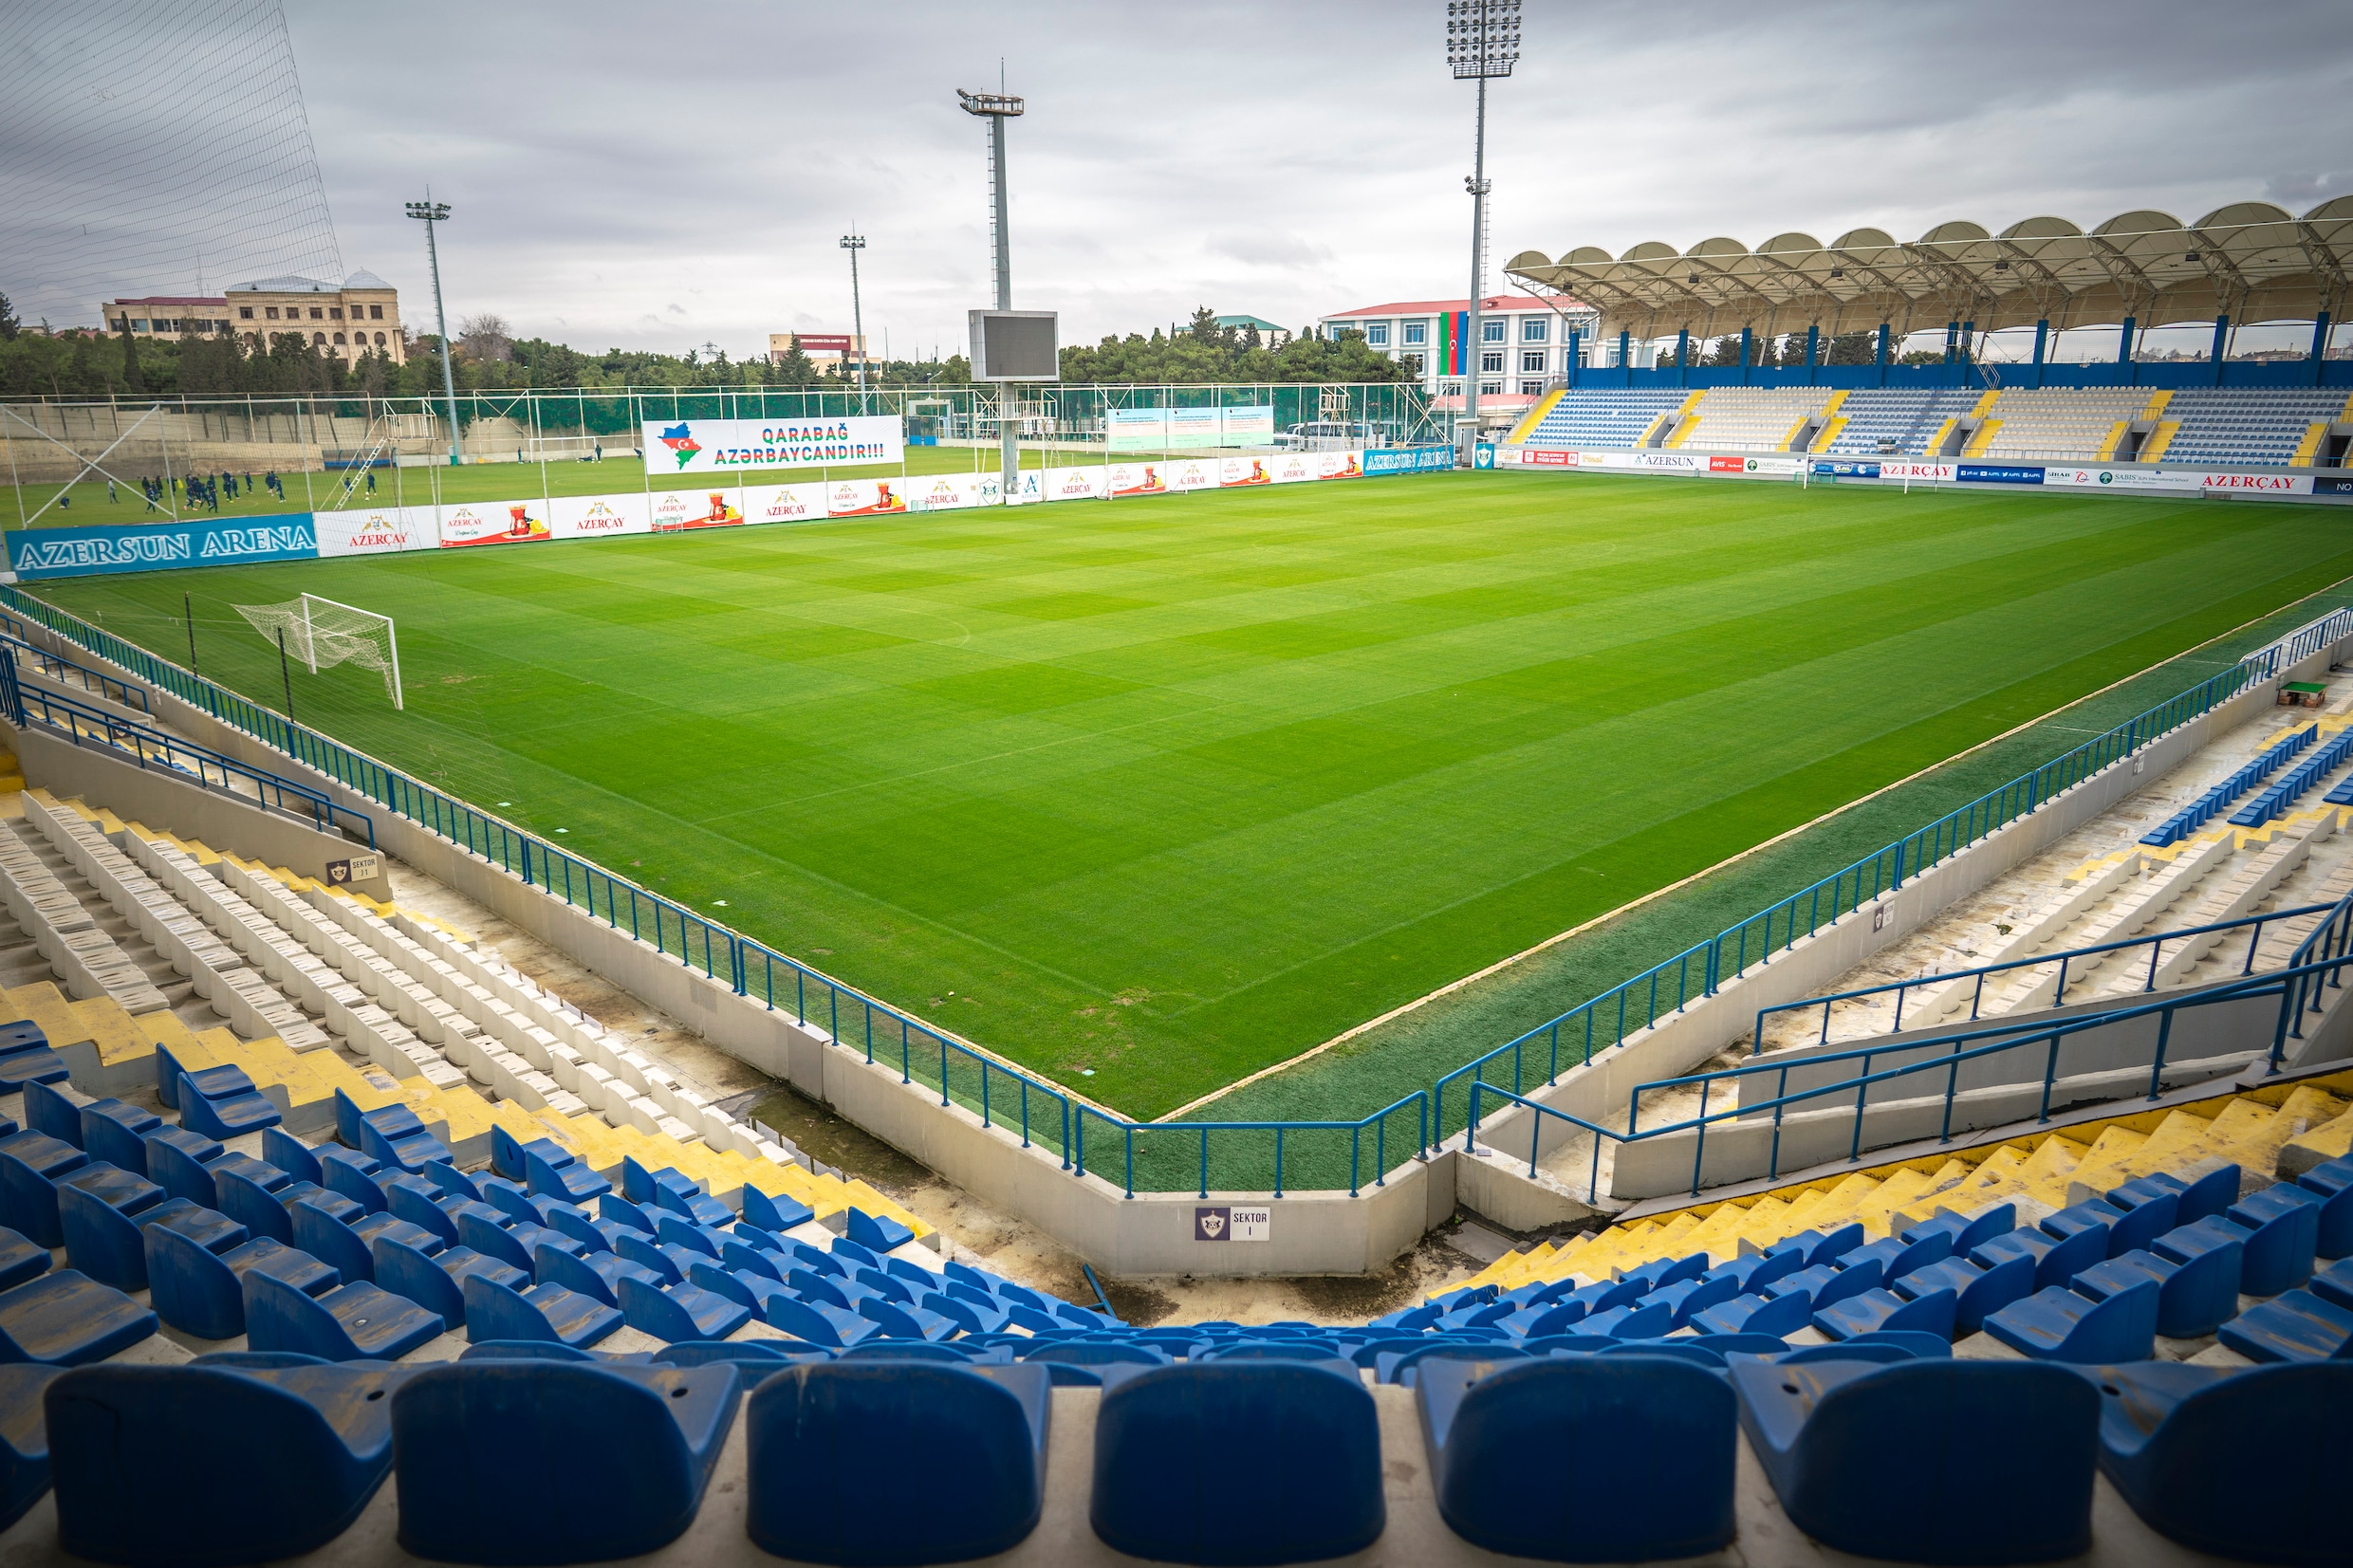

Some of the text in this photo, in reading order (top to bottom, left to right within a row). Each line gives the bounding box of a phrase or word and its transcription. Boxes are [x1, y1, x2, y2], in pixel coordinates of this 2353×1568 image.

[762, 422, 848, 445] QARABAĞ
[714, 443, 884, 465] AZƏRBAYCANDIR!!!
[1366, 450, 1452, 470] AZERSUN ARENA
[1645, 455, 1694, 468] AZERSUN
[1880, 462, 1952, 479] AZERÇAY
[1061, 484, 1092, 494] AZERÇAY
[2201, 475, 2296, 490] AZERÇAY
[2336, 483, 2352, 491] NO
[833, 492, 859, 501] AZERÇAY
[925, 493, 959, 504] AZERÇAY
[657, 505, 688, 513] AZERÇAY
[766, 504, 806, 517] AZERÇAY
[448, 516, 483, 527] AZERÇAY
[576, 517, 626, 530] AZERÇAY
[349, 531, 409, 547] AZERÇAY
[16, 526, 316, 570] AZERSUN ARENA
[352, 858, 376, 869] SEKTOR
[1233, 1212, 1267, 1223] SEKTOR
